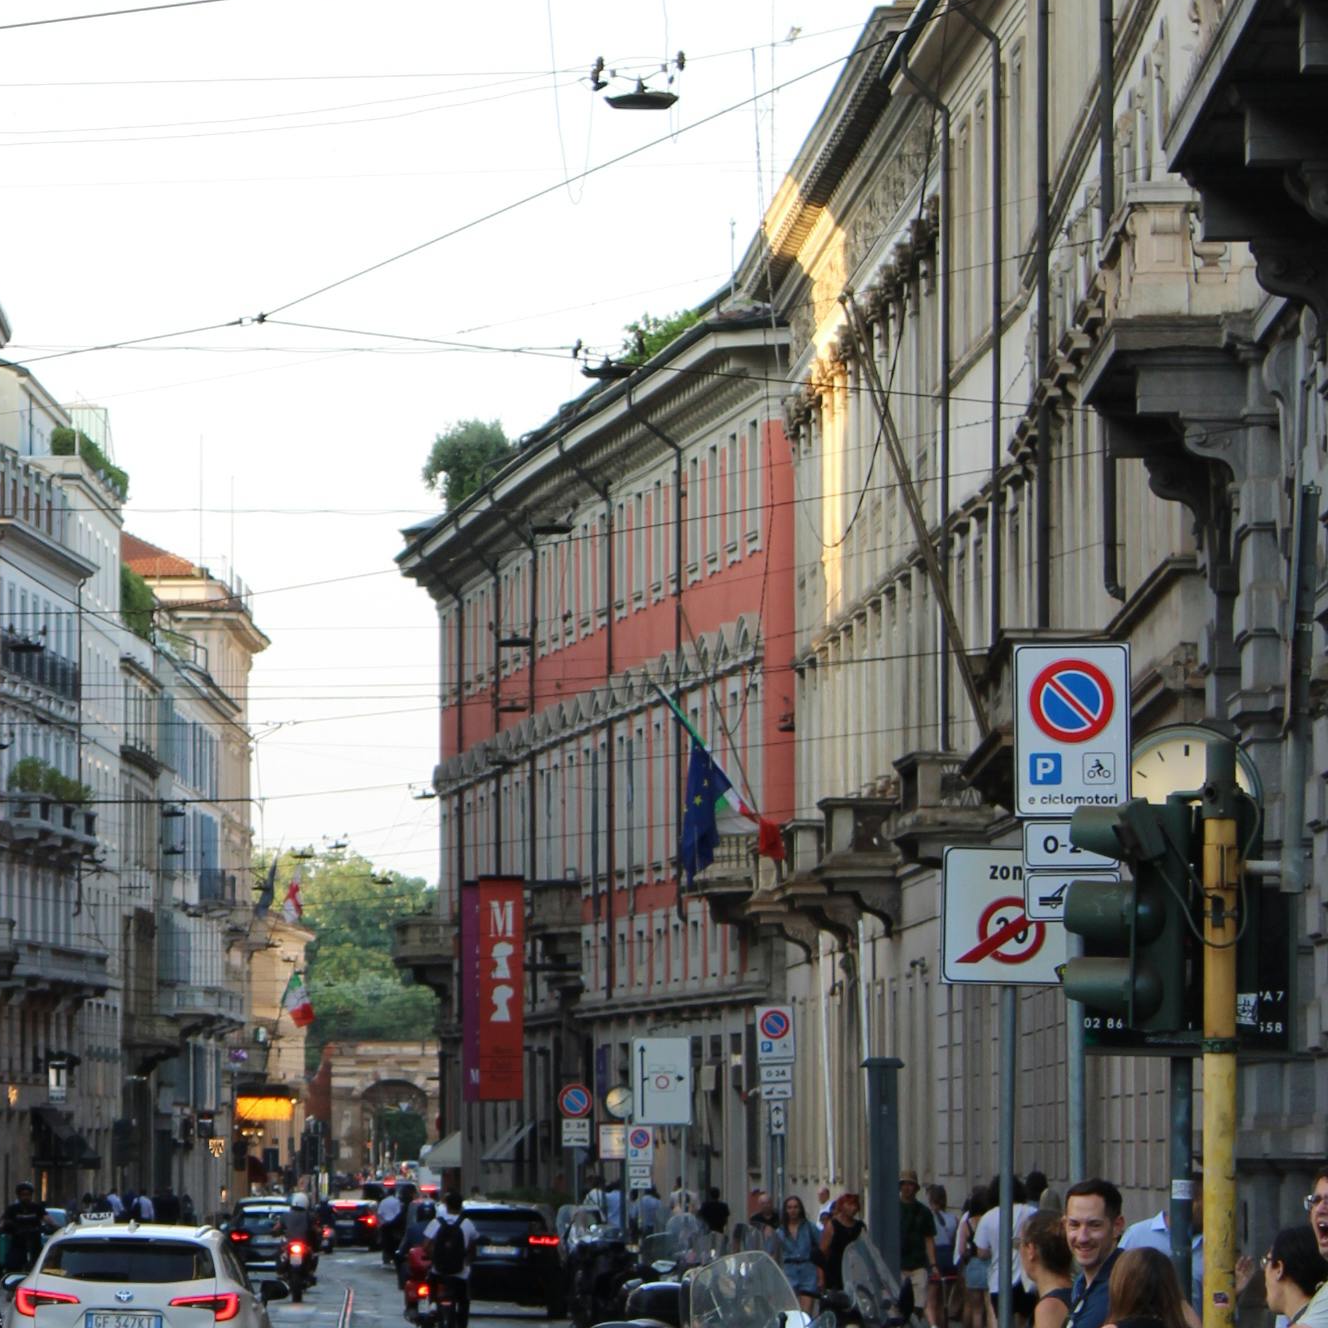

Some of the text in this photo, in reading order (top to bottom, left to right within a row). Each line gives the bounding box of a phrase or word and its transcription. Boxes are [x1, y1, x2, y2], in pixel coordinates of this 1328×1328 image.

[1036, 757, 1055, 781] P
[1028, 793, 1119, 805] e ciclomotori
[989, 865, 1023, 880] zon
[489, 900, 514, 937] M
[1276, 990, 1284, 1002] 7
[1083, 1018, 1100, 1030] 02
[86, 1212, 112, 1220] TAXI
